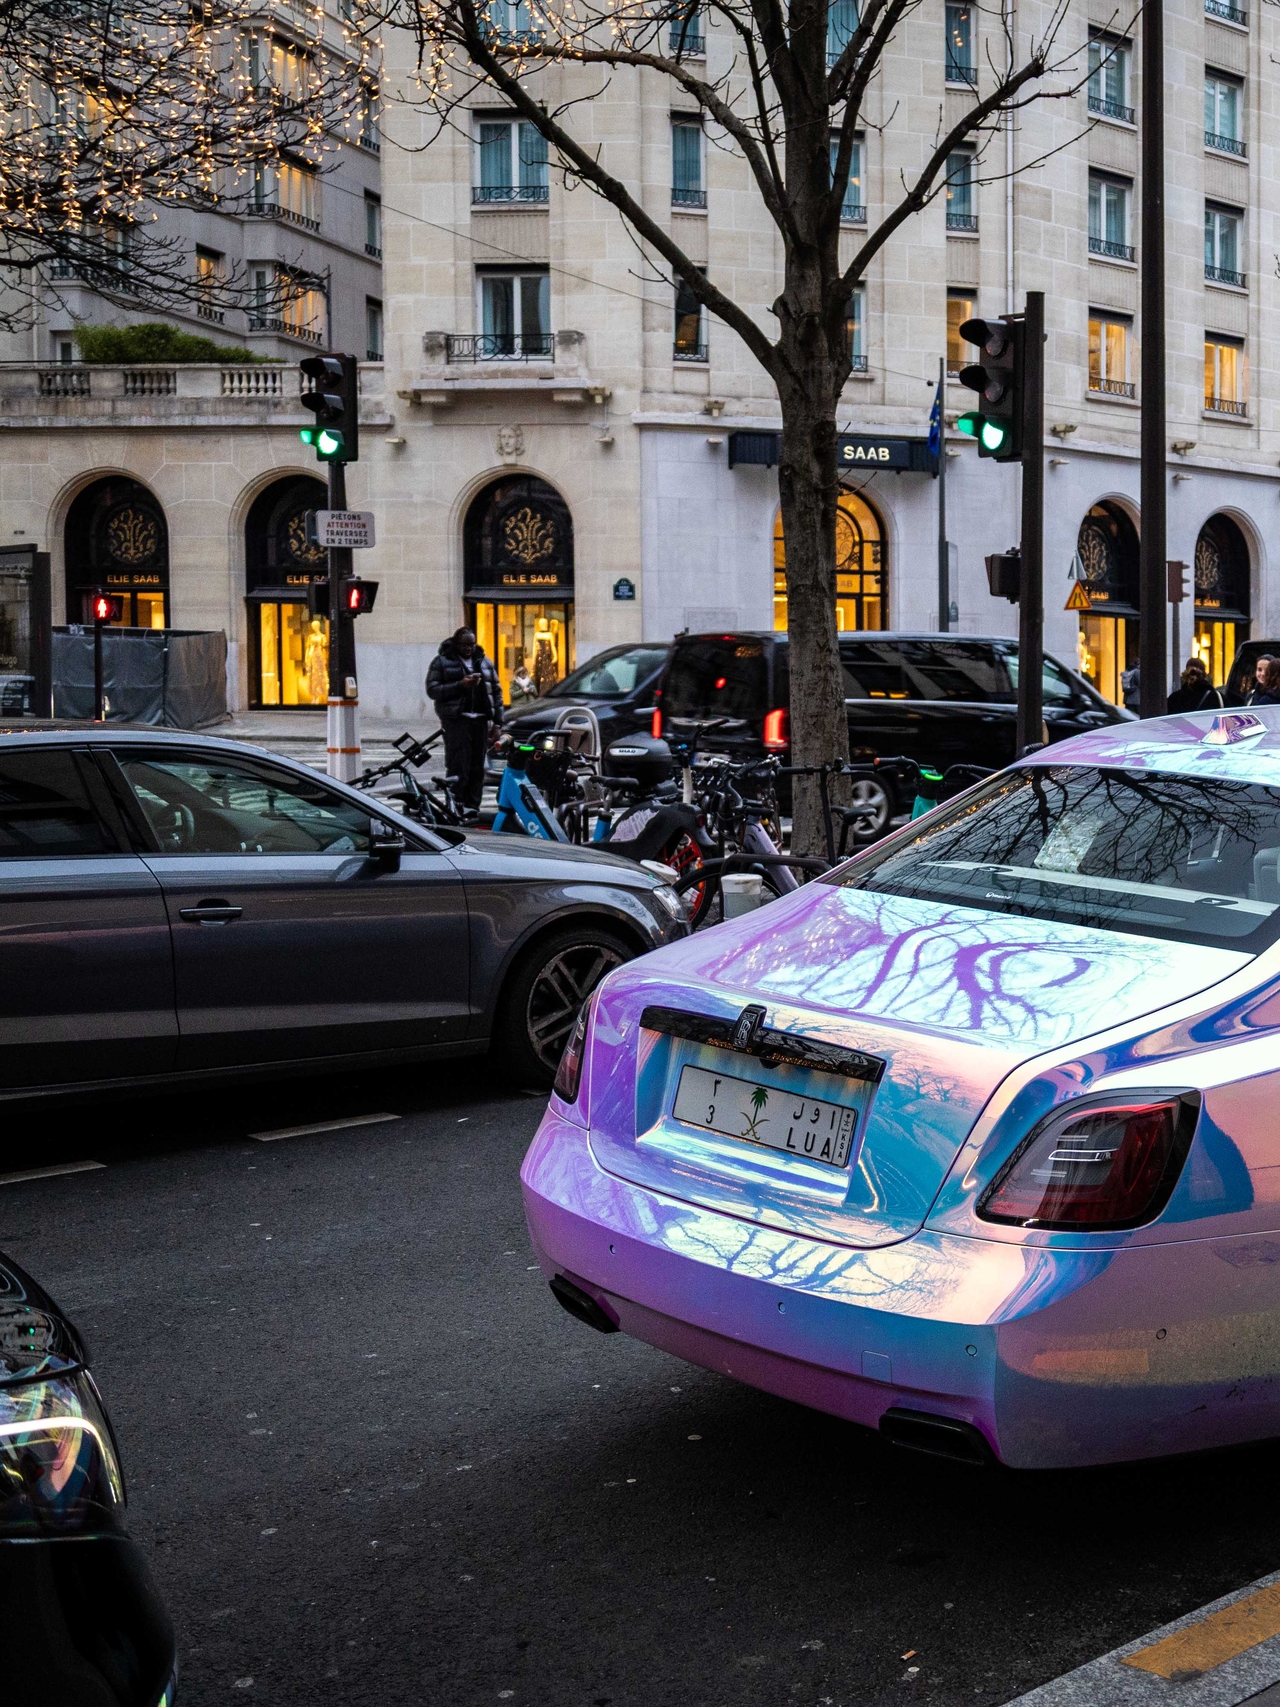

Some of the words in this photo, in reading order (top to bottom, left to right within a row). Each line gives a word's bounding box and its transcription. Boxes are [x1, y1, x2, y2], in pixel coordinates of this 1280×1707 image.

[843, 445, 890, 461] SAAB
[107, 575, 129, 583] ELIE
[133, 575, 160, 583] SAAB
[286, 575, 310, 583] ELIE
[503, 575, 526, 583] ELIE
[530, 575, 558, 583] SAAB
[1090, 591, 1109, 600] SAAB
[705, 1104, 716, 1125] 3
[786, 1126, 832, 1160] LUA
